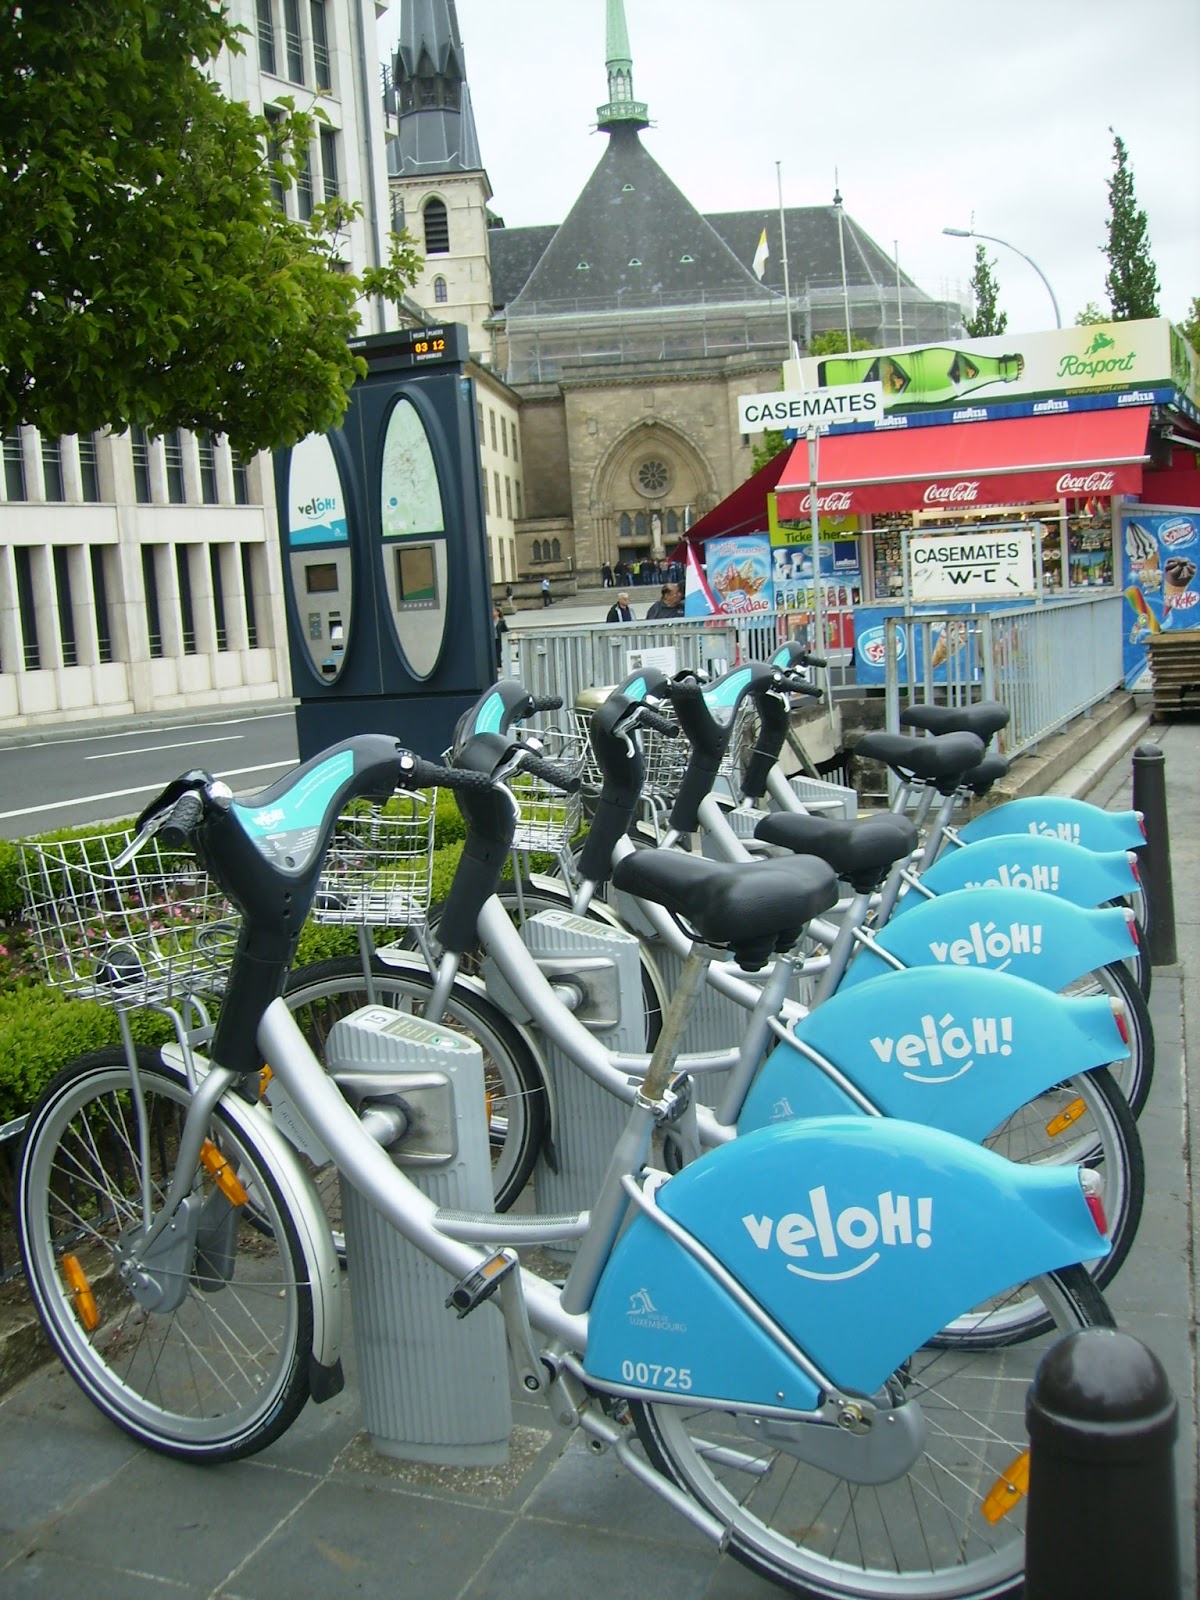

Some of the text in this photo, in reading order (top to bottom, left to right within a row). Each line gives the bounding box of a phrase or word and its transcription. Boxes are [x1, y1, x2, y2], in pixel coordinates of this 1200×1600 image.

[415, 339, 445, 353] 03 12
[1056, 351, 1137, 378] Rosport
[744, 393, 877, 422] CASEMATES
[924, 481, 980, 504] Coca-Cola
[1056, 471, 1115, 493] Coca-Cola
[799, 492, 854, 513] Coa-Cola
[784, 532, 822, 543] Tickes
[914, 542, 1019, 564] CASEMATES
[622, 1360, 692, 1390] 00725
